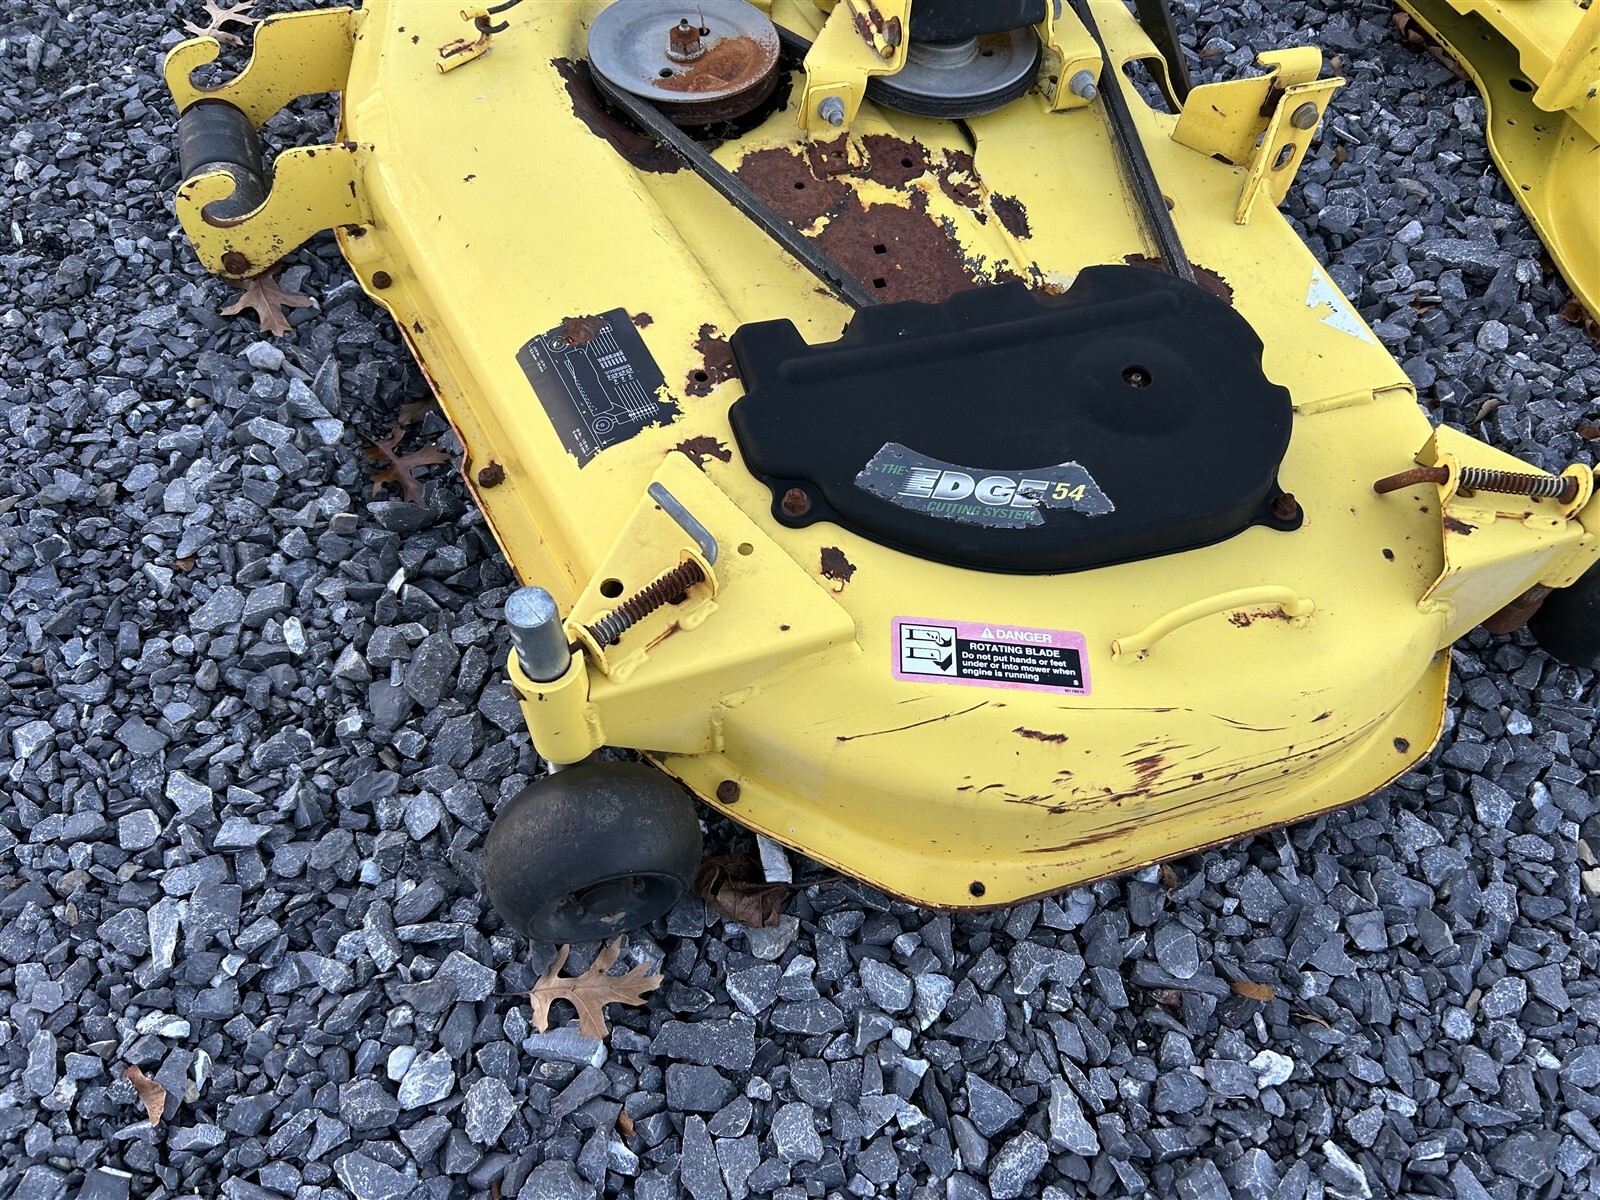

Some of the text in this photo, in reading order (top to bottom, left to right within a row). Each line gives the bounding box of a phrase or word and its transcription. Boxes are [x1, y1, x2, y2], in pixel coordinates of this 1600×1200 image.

[880, 463, 905, 476] THE
[1051, 482, 1086, 502] 54
[927, 501, 1036, 521] CUTTING SYSTEM
[996, 629, 1052, 643] DANGER
[970, 642, 1060, 658] ROTATING BLADE
[962, 651, 974, 659] Do
[976, 653, 991, 661] not
[993, 655, 1008, 663] put
[1010, 655, 1037, 665] hands
[1050, 659, 1067, 668] feet
[962, 660, 988, 668] under
[1002, 662, 1019, 671] into
[1021, 665, 1050, 674] mower
[1052, 667, 1076, 676] when
[962, 667, 1039, 682] engine is running
